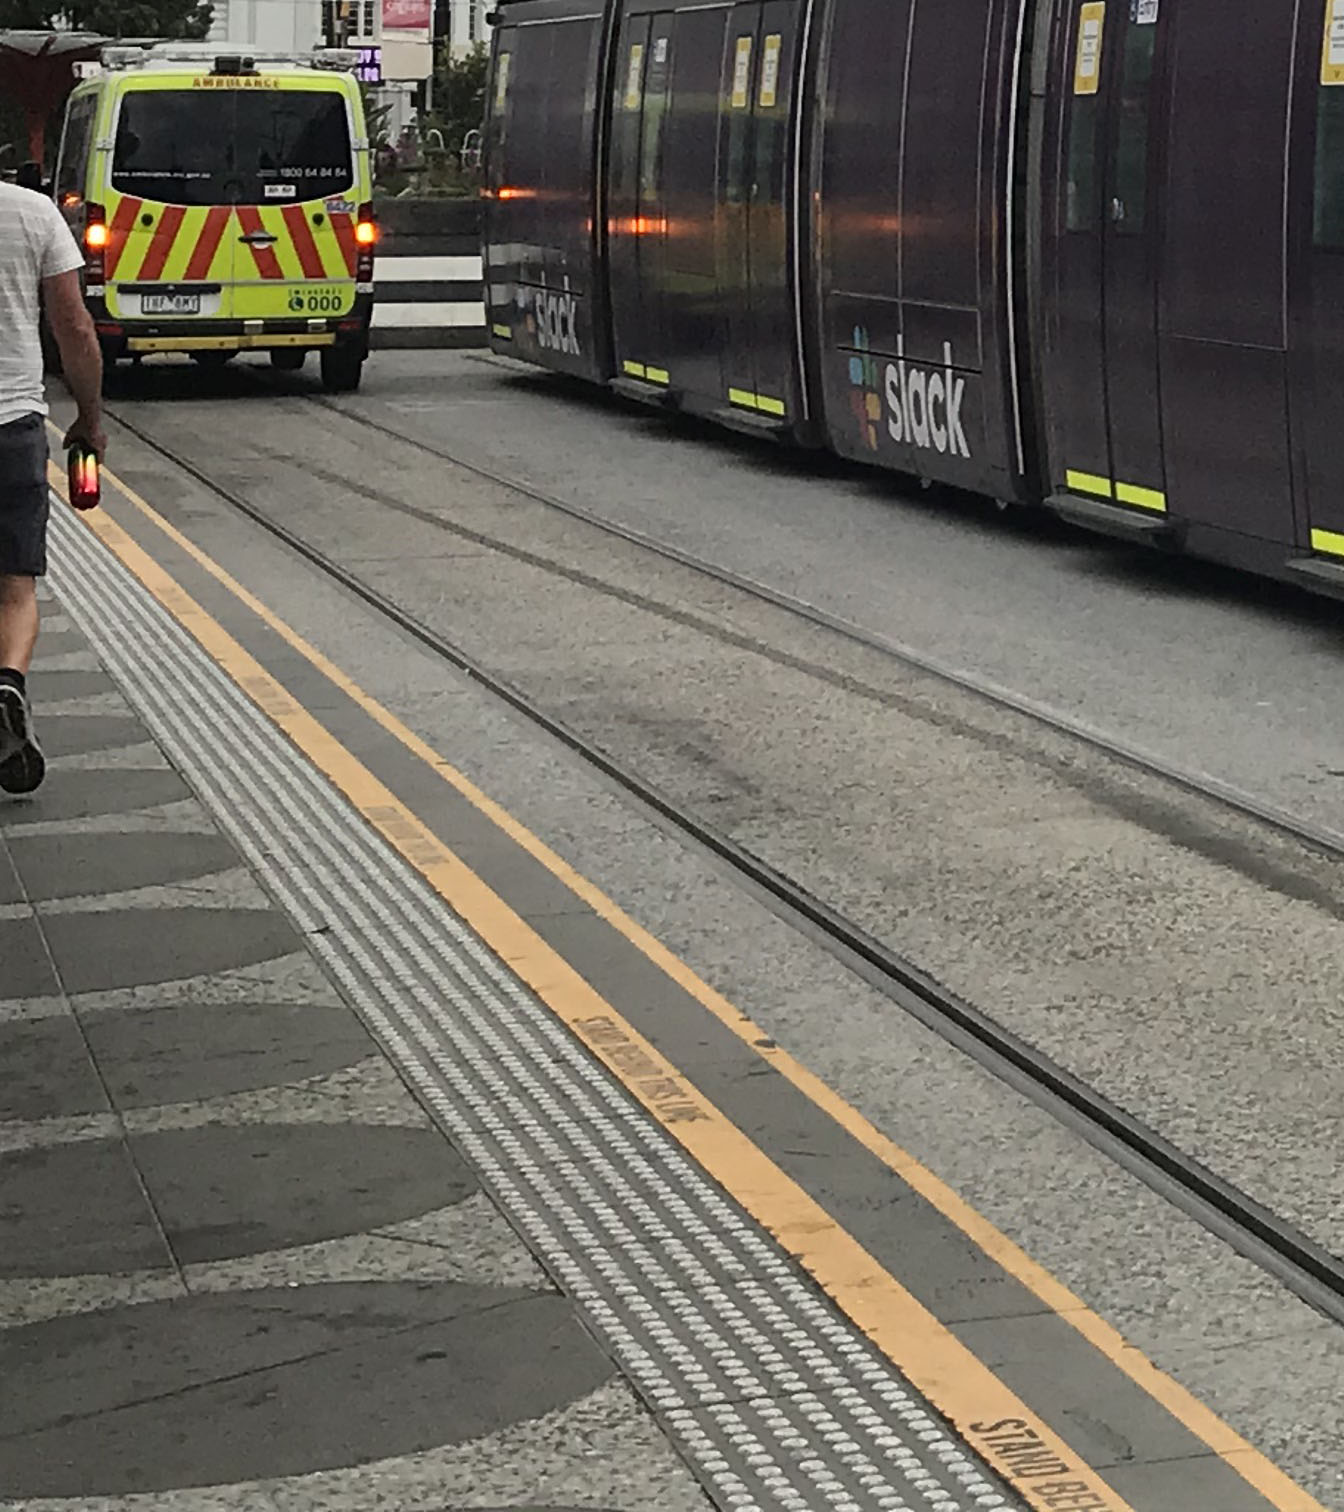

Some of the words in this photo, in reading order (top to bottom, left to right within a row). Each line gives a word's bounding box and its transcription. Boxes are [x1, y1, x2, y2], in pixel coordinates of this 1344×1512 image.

[191, 75, 282, 90] AMBULANCE
[307, 295, 342, 312] 000
[536, 270, 581, 357] slack
[885, 333, 971, 459] slack
[968, 1417, 1071, 1479] STAND
